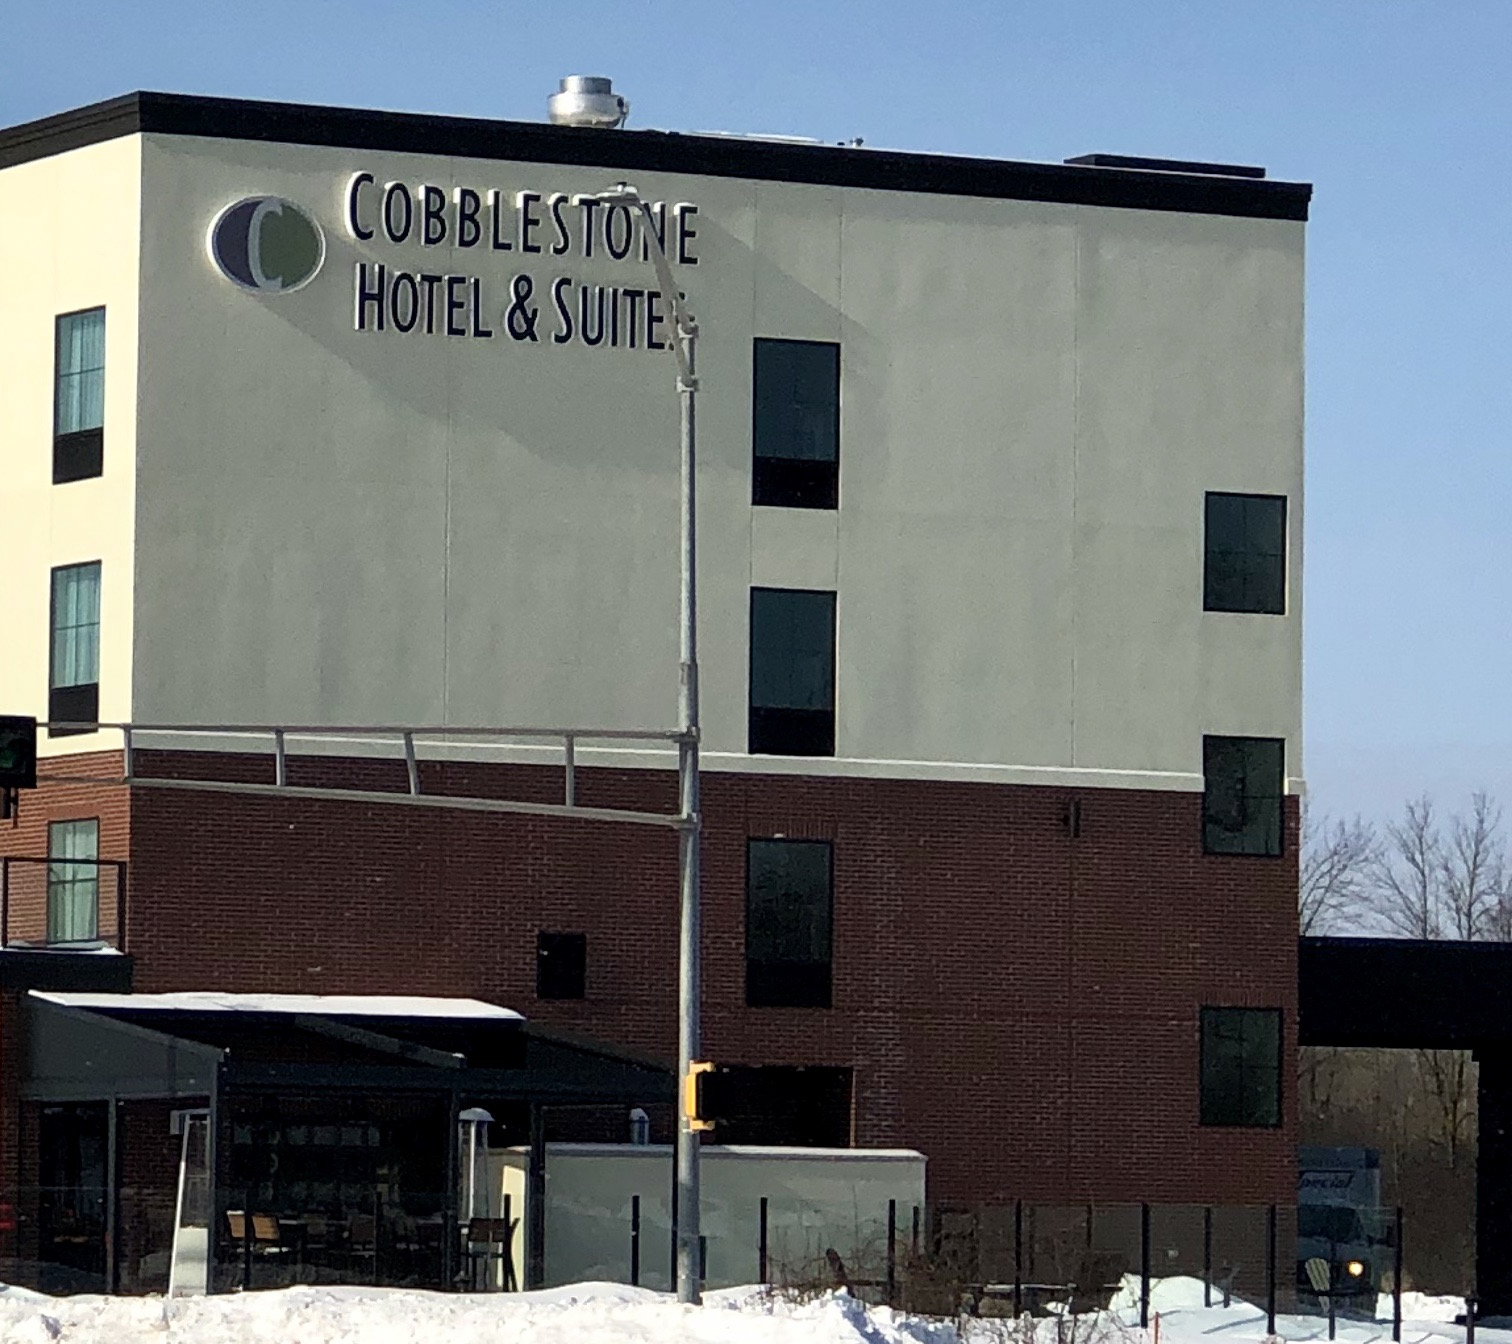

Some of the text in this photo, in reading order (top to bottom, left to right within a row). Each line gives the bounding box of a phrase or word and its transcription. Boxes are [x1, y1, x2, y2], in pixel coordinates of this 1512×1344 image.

[345, 171, 699, 265] COBBLESTONE
[355, 262, 686, 351] HOTEL & SUITE
